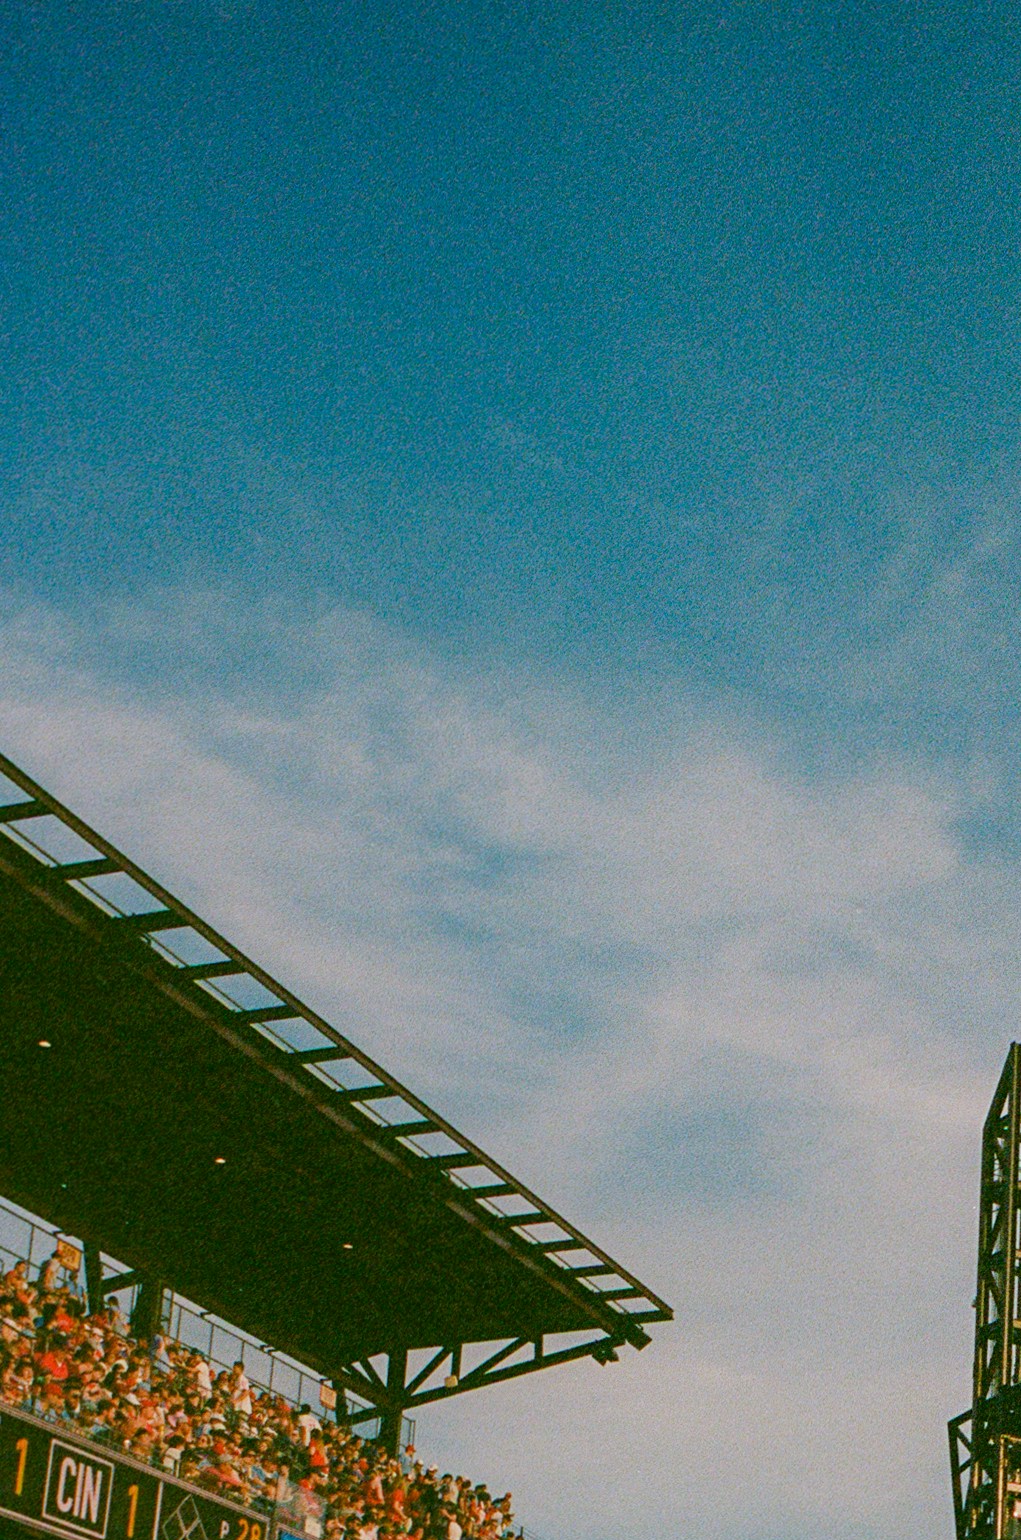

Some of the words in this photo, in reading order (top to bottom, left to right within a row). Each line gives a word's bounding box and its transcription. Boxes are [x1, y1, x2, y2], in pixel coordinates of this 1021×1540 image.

[15, 1438, 28, 1496] 1
[57, 1456, 103, 1524] CIN
[127, 1484, 139, 1538] 1
[220, 1519, 230, 1539] P
